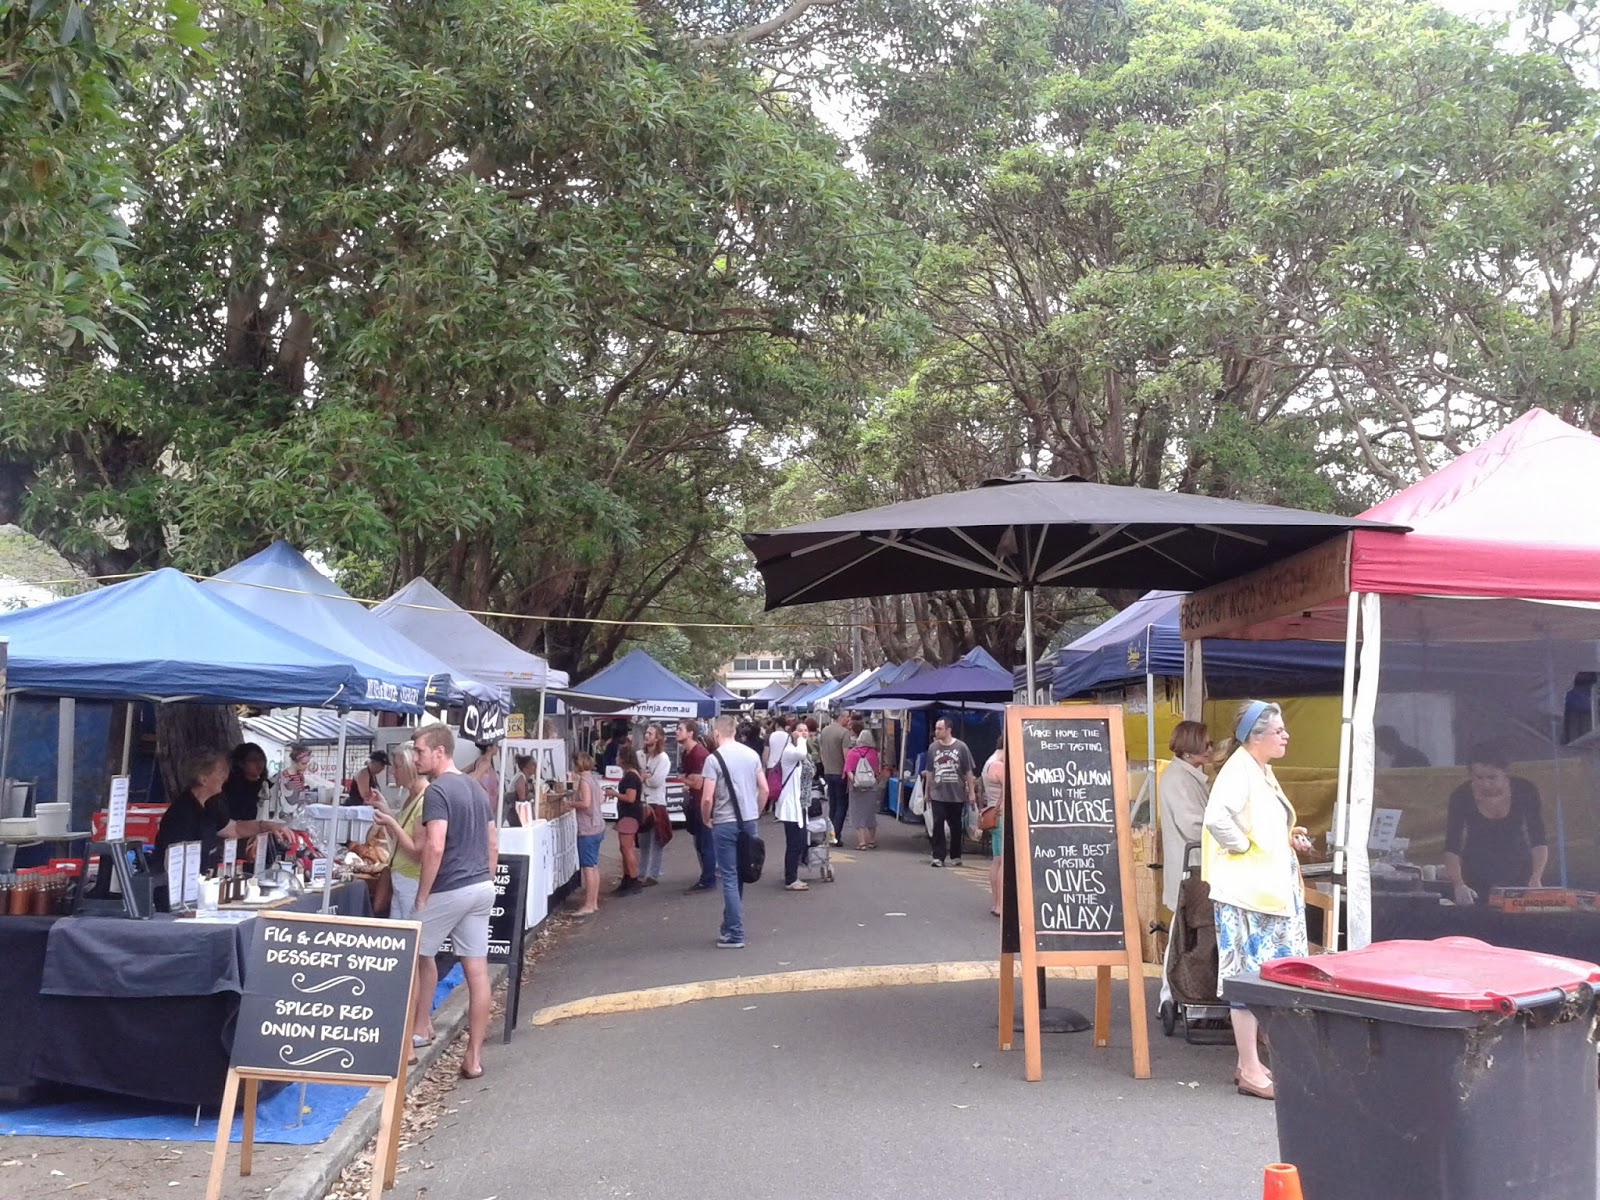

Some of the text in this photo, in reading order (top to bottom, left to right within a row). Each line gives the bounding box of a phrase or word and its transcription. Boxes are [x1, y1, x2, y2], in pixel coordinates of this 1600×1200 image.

[1023, 725, 1100, 738] TAKE HOME THE
[1040, 740, 1103, 752] BEST TASTING
[1025, 760, 1111, 786] SMOKED SALMON
[1051, 786, 1087, 799] IN THE
[1027, 798, 1114, 823] UNIVERSE
[1034, 843, 1111, 858] AND THE BEST
[1053, 857, 1096, 869] TASTING
[1045, 868, 1106, 895] OLIVES
[1063, 893, 1098, 905] IN THE
[1041, 902, 1114, 930] GALAXY
[264, 926, 406, 951] FIG & CARDAMOM
[266, 949, 398, 972] DESSERT SYRUP
[274, 999, 374, 1020] SPICED RED
[260, 1020, 380, 1044] ONION RELISH
